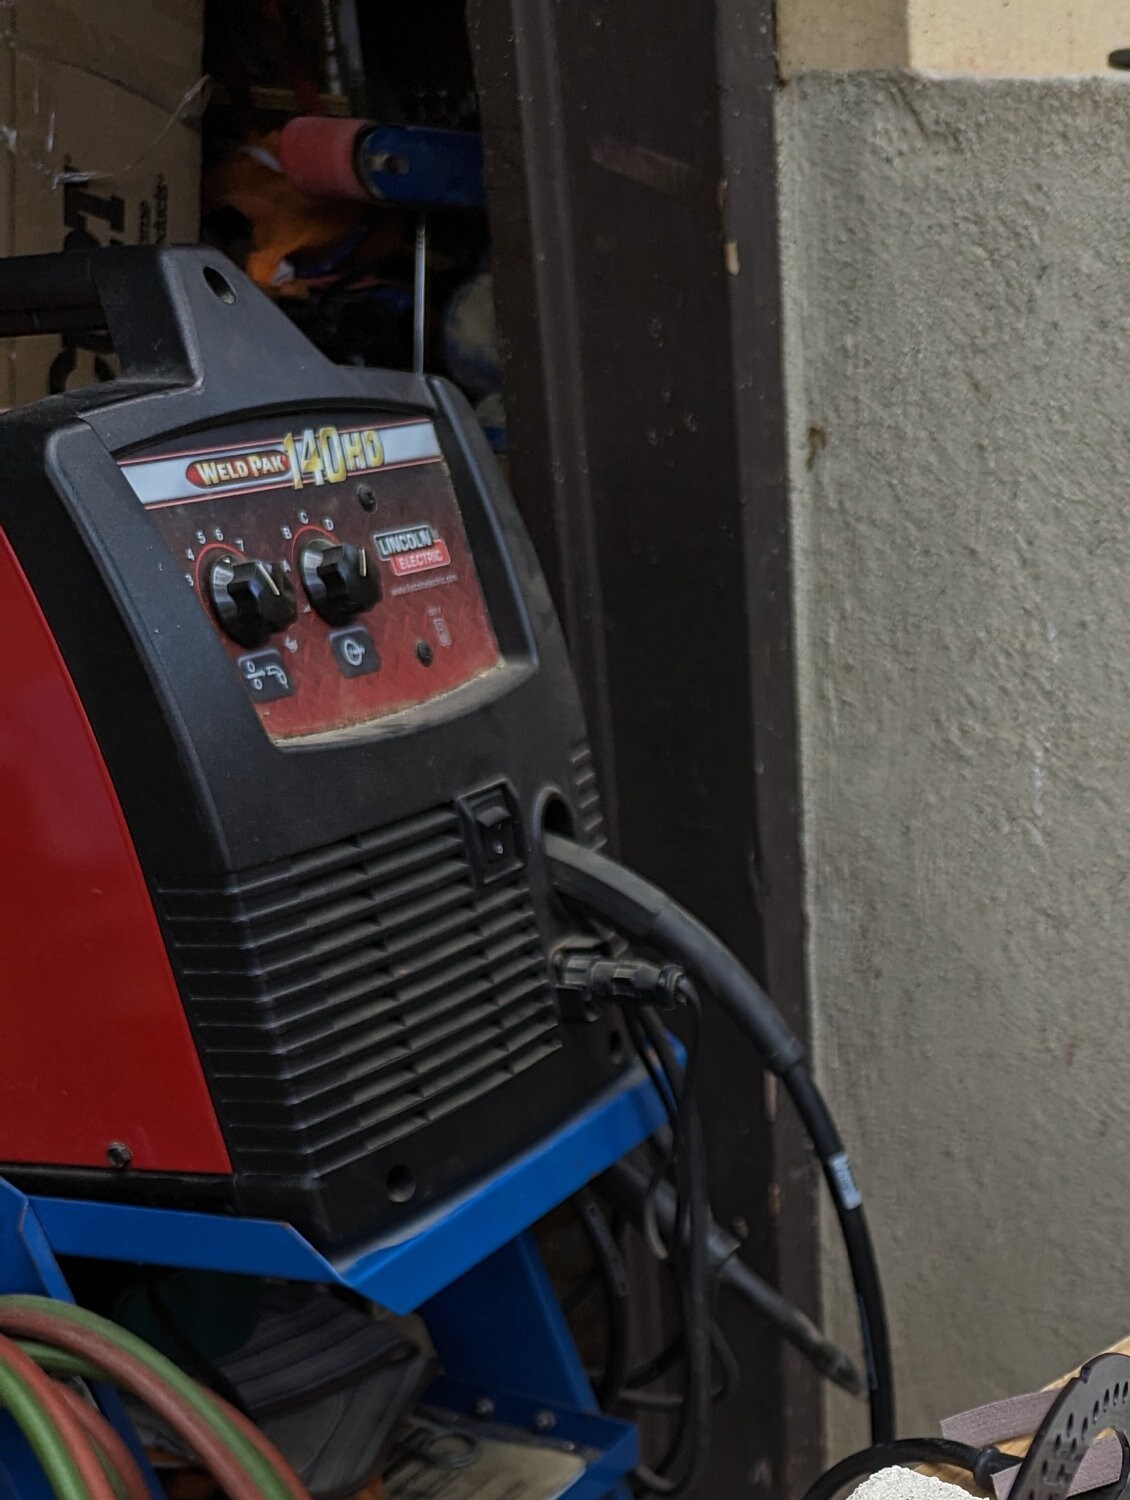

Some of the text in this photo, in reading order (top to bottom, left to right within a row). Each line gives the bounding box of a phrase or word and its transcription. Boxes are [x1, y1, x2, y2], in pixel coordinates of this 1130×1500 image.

[197, 457, 249, 485] WELD
[248, 454, 285, 477] PAK
[281, 526, 292, 540] B
[300, 511, 308, 524] C
[324, 518, 334, 531] D
[379, 529, 433, 555] LINCOLN
[185, 527, 244, 587] 3 4 5 6 7
[398, 549, 443, 570] ELECTRIC
